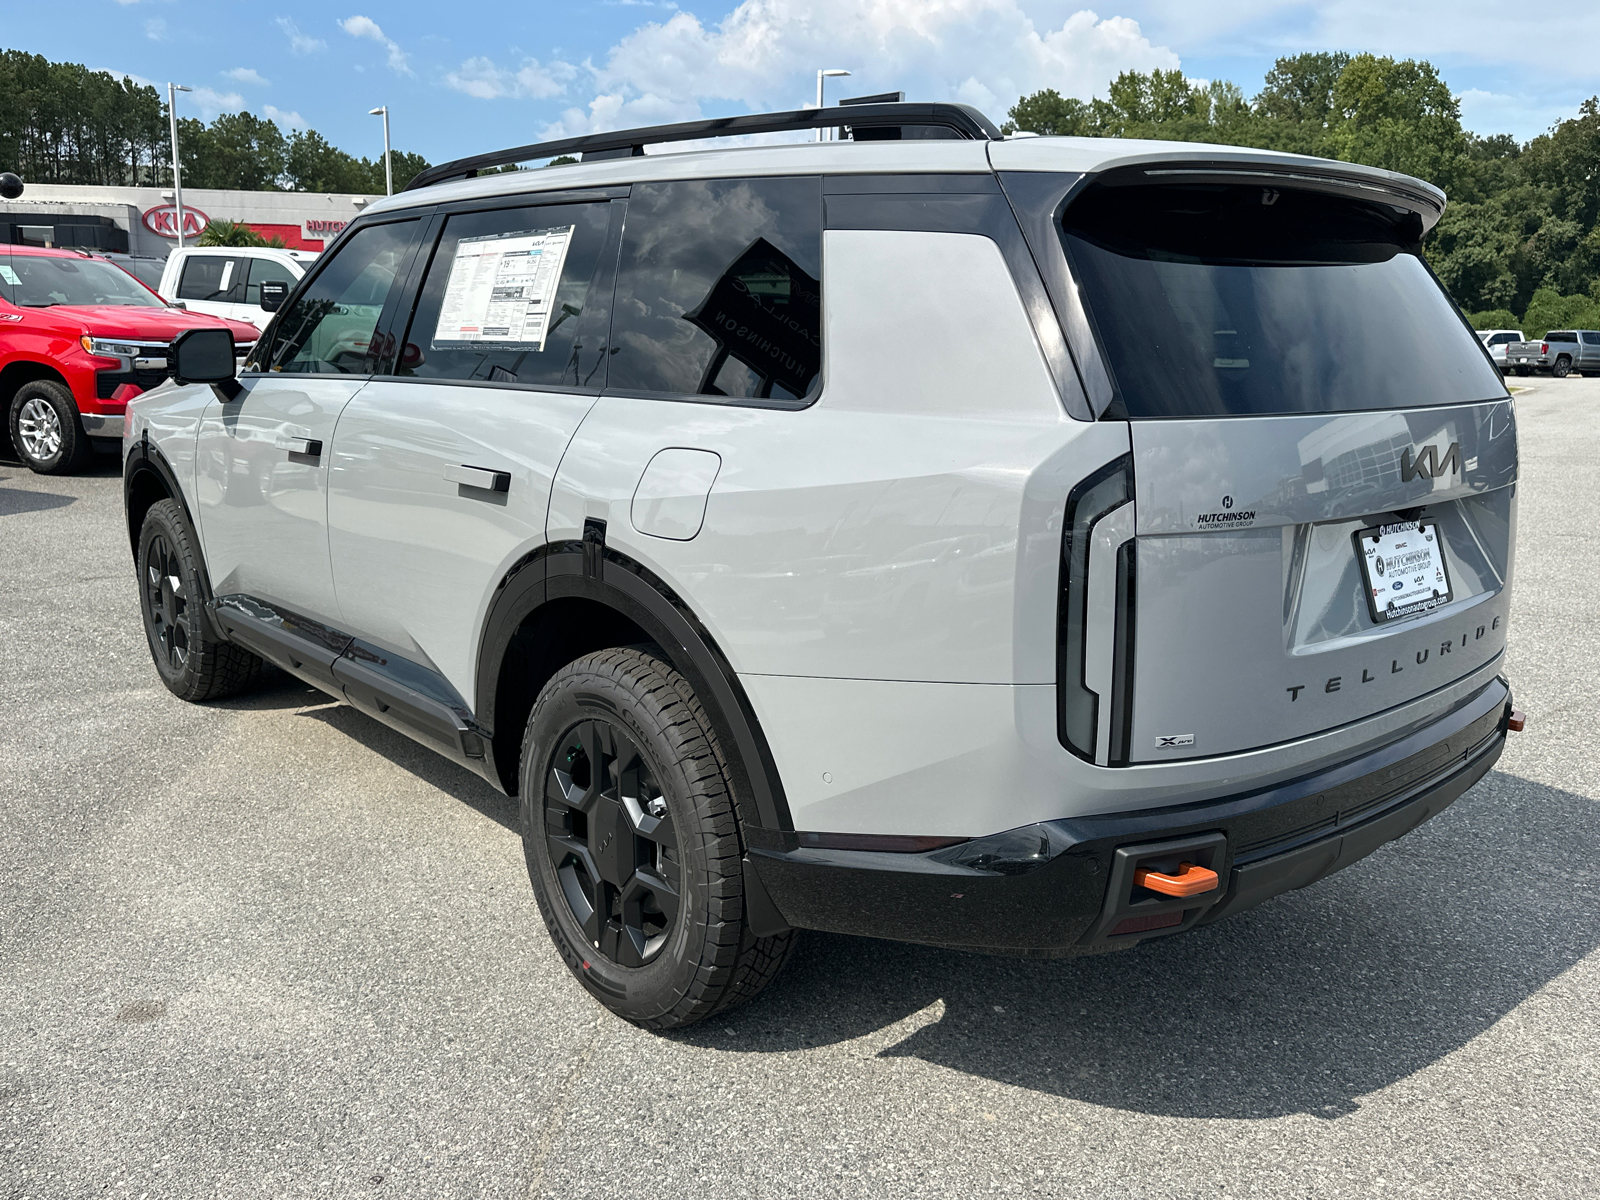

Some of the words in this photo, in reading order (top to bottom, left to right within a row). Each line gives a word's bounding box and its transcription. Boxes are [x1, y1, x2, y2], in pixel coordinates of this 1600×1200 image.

[153, 212, 200, 232] KIA
[1400, 442, 1461, 483] KIA
[1197, 511, 1256, 523] HUTCHINSON
[1198, 522, 1235, 530] AUTOMOTIVE
[1236, 520, 1254, 528] GROUP
[1386, 520, 1420, 535] HUTCHINSON
[1385, 548, 1432, 571] HUTCHINSON
[1388, 565, 1418, 578] AUTOMOTIVE
[1417, 561, 1432, 573] GROUP
[1286, 616, 1501, 702] TELLURIDE
